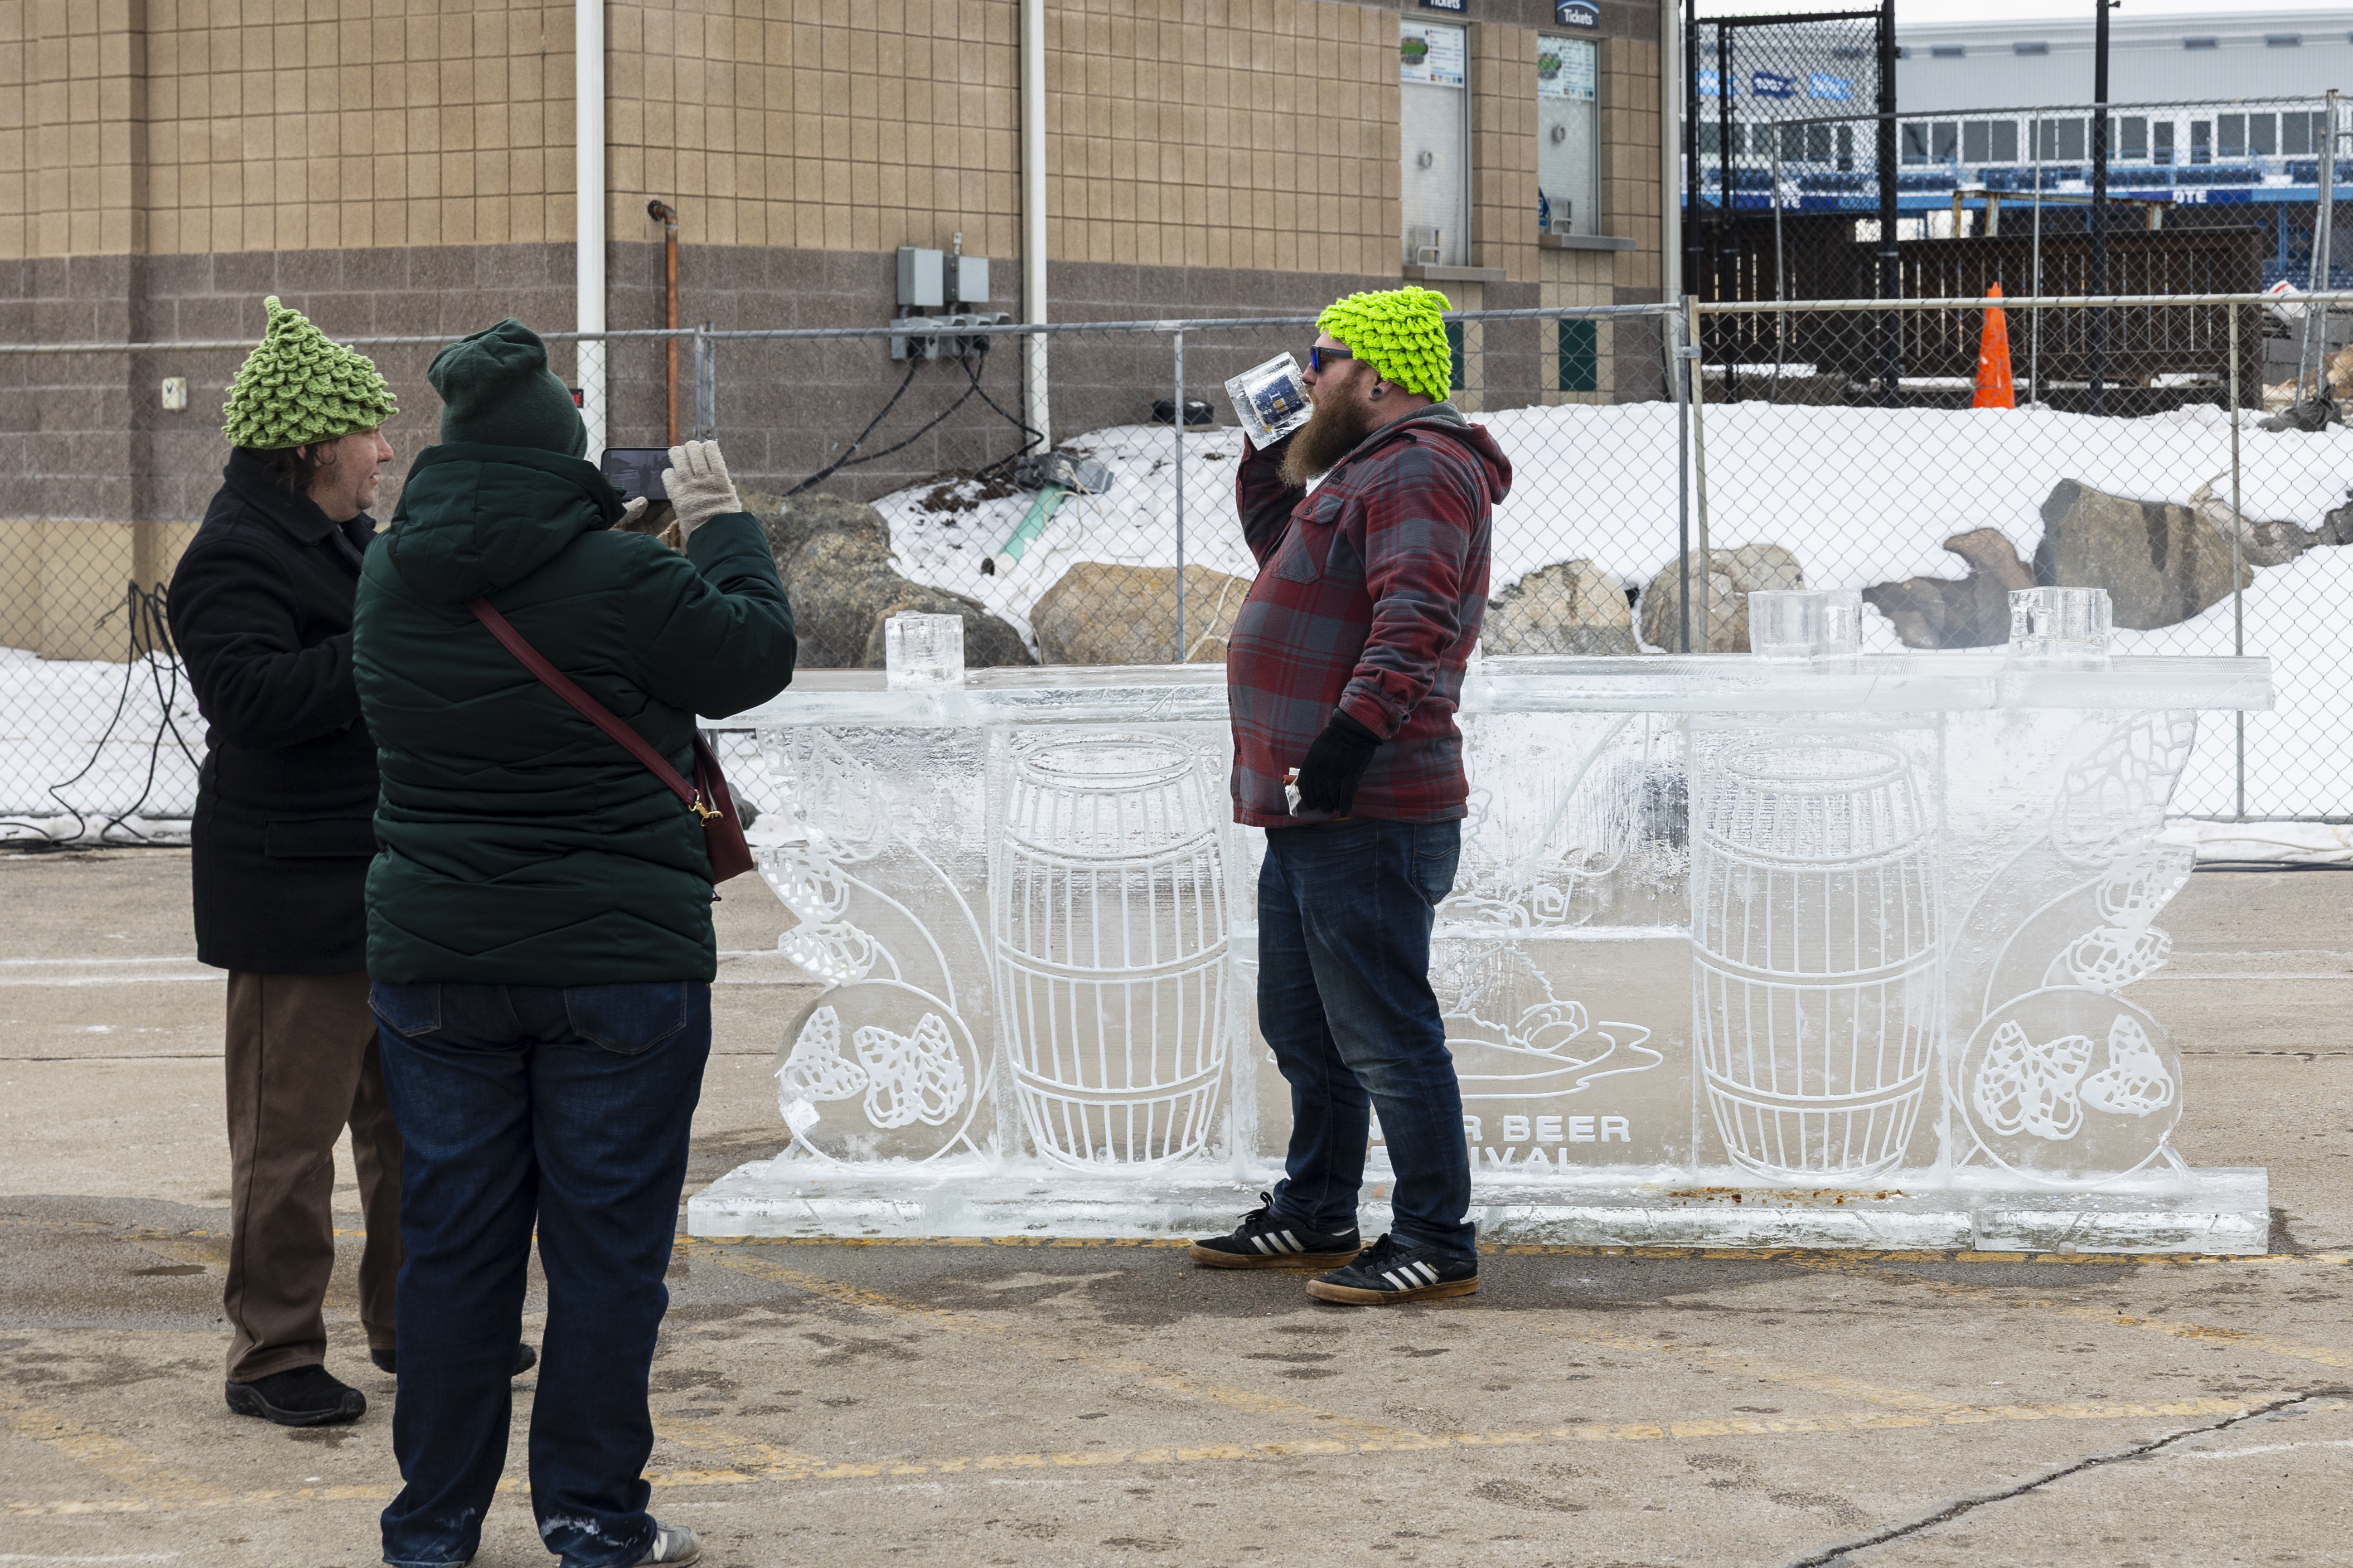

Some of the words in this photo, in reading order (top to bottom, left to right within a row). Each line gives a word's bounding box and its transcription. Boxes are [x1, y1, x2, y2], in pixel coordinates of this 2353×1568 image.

[1563, 8, 1593, 25] Tickets
[2172, 190, 2207, 203] DTE
[1503, 1115, 1631, 1142] BEER
